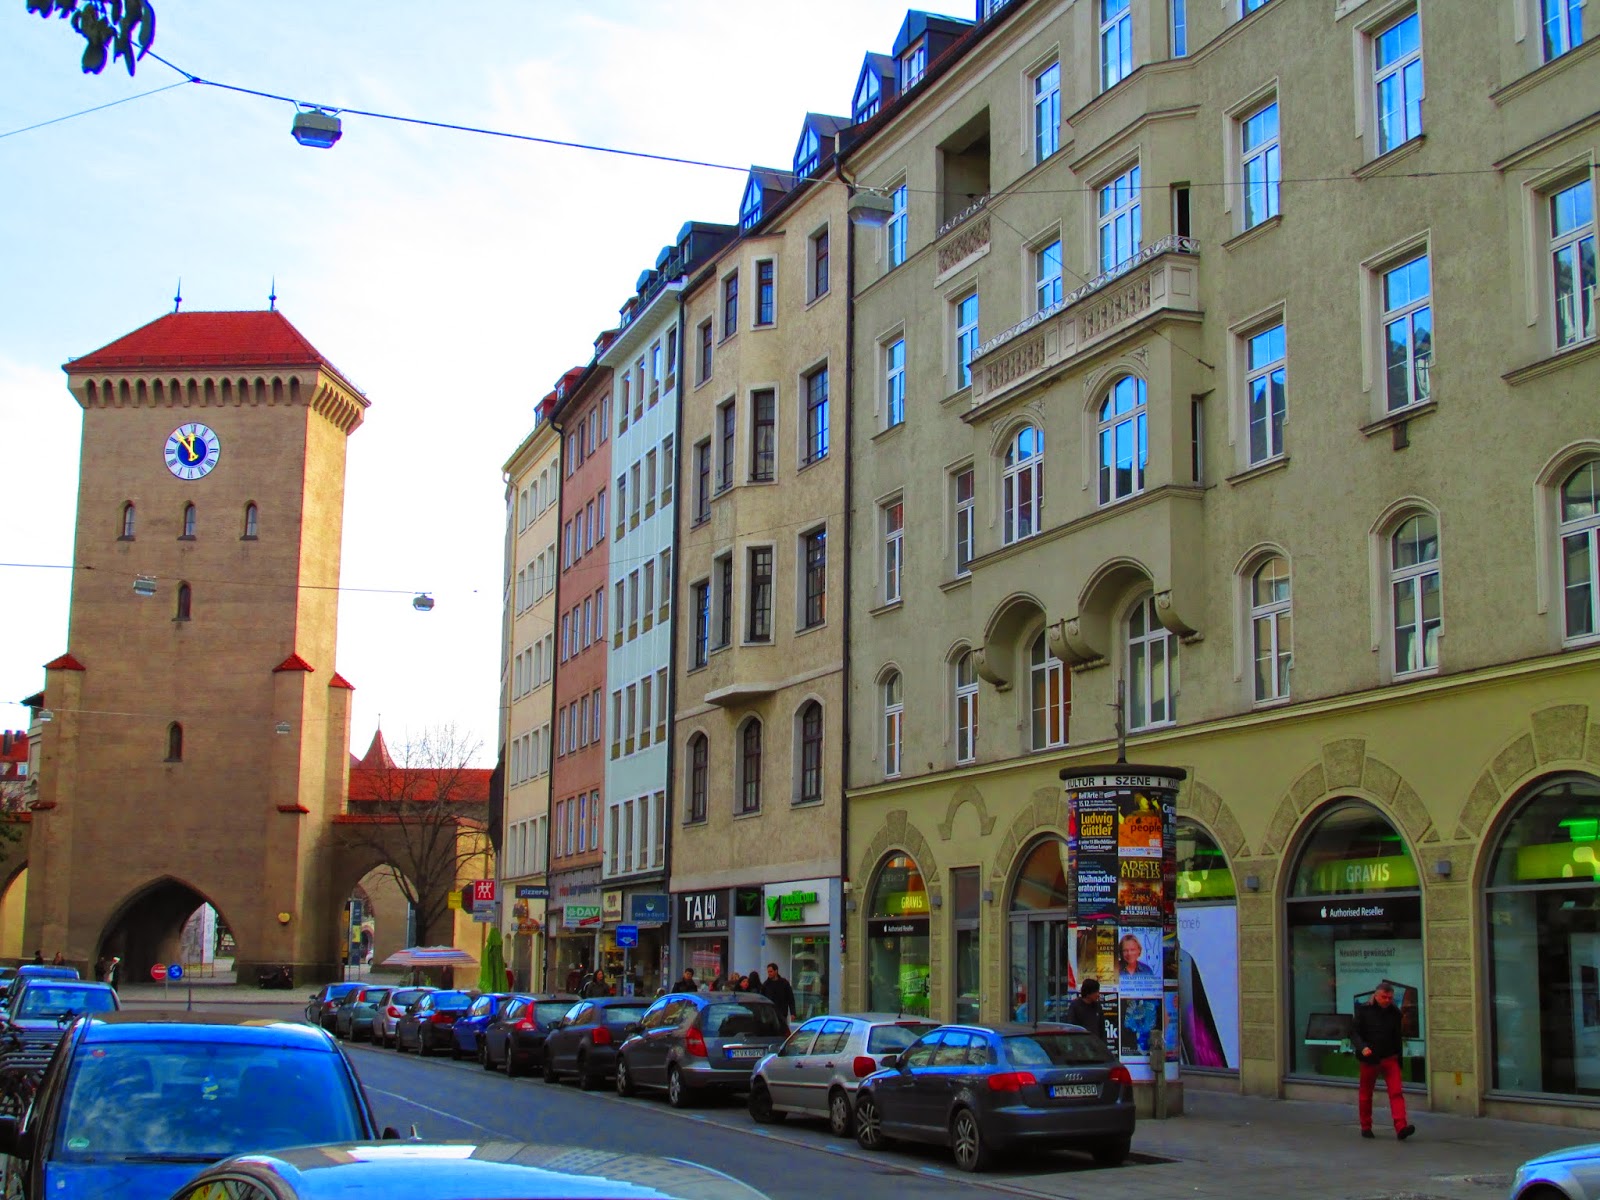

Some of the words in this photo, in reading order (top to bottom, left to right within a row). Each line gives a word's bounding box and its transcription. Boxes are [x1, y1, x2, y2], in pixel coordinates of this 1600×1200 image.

[1067, 777, 1095, 788] KULTUR
[1115, 776, 1151, 786] SZENE
[1080, 813, 1113, 826] Ludwig
[1080, 825, 1113, 838] Güttler
[1130, 822, 1162, 835] people
[1121, 860, 1160, 869] ADESTE
[1121, 869, 1161, 879] FIDELES
[1346, 864, 1389, 882] GRAVIS
[1078, 874, 1117, 884] Weihnachts
[1078, 883, 1111, 893] oratorium
[901, 896, 922, 909] GRAVIS
[576, 907, 599, 917] DAV
[1329, 907, 1361, 917] Authorised
[1361, 906, 1385, 916] Reseller
